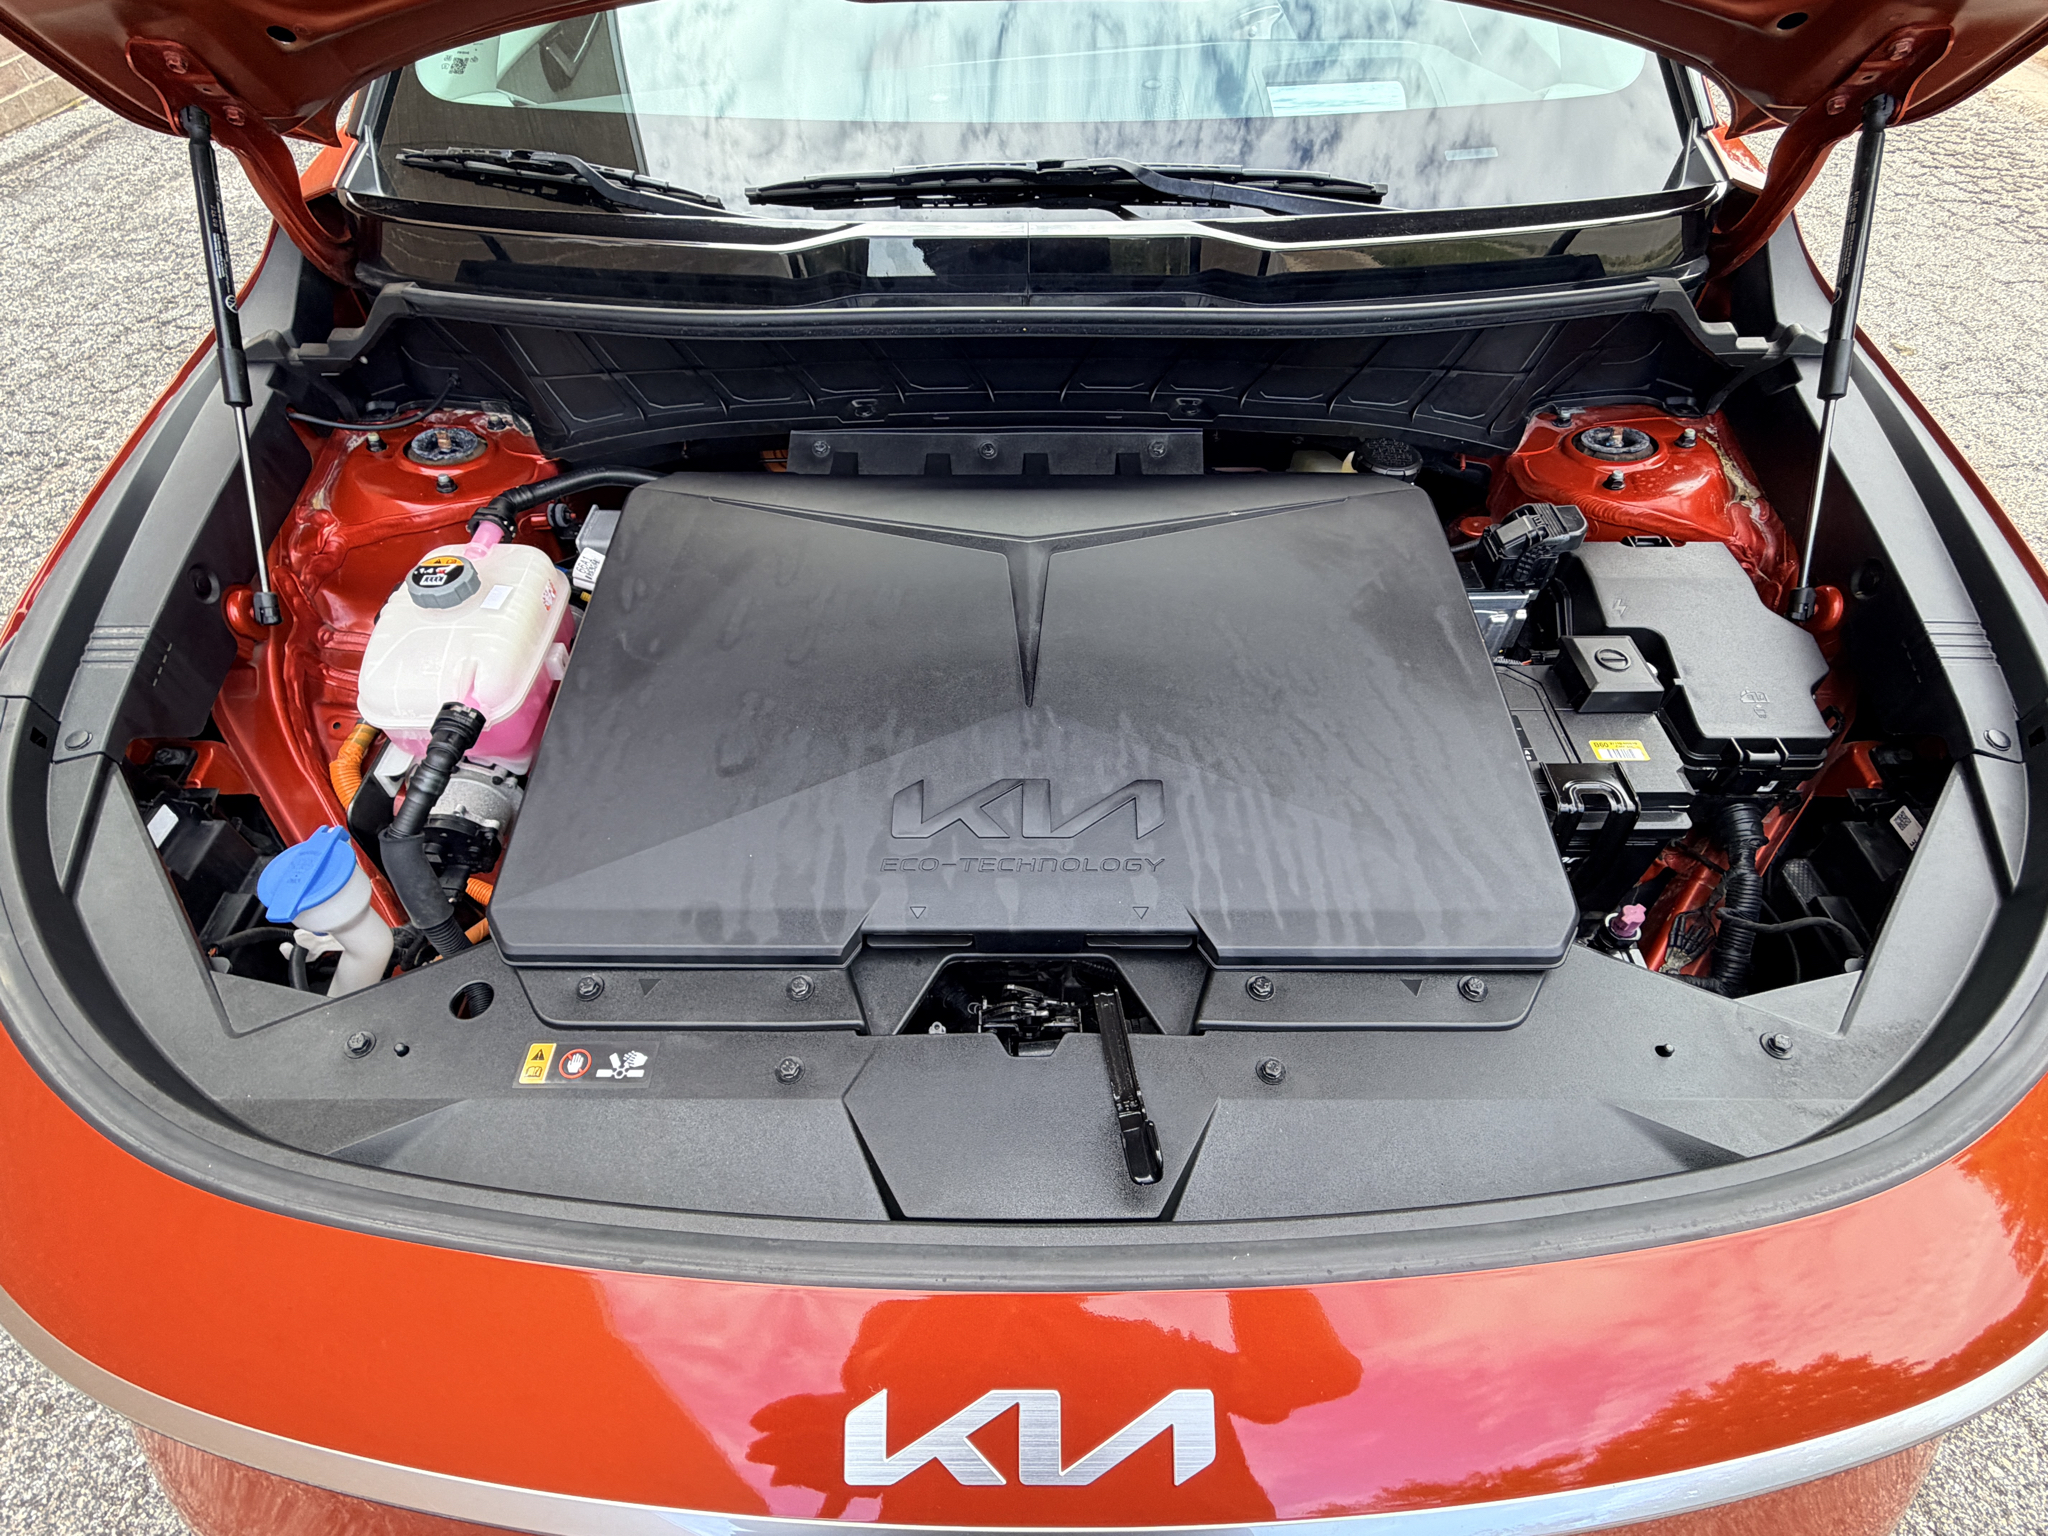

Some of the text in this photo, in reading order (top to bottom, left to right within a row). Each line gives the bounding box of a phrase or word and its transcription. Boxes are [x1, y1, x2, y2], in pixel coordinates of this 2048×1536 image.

[890, 778, 1166, 840] KIA
[880, 857, 1166, 873] ECO-TECHNOLOGY
[844, 1389, 1216, 1486] KIA
